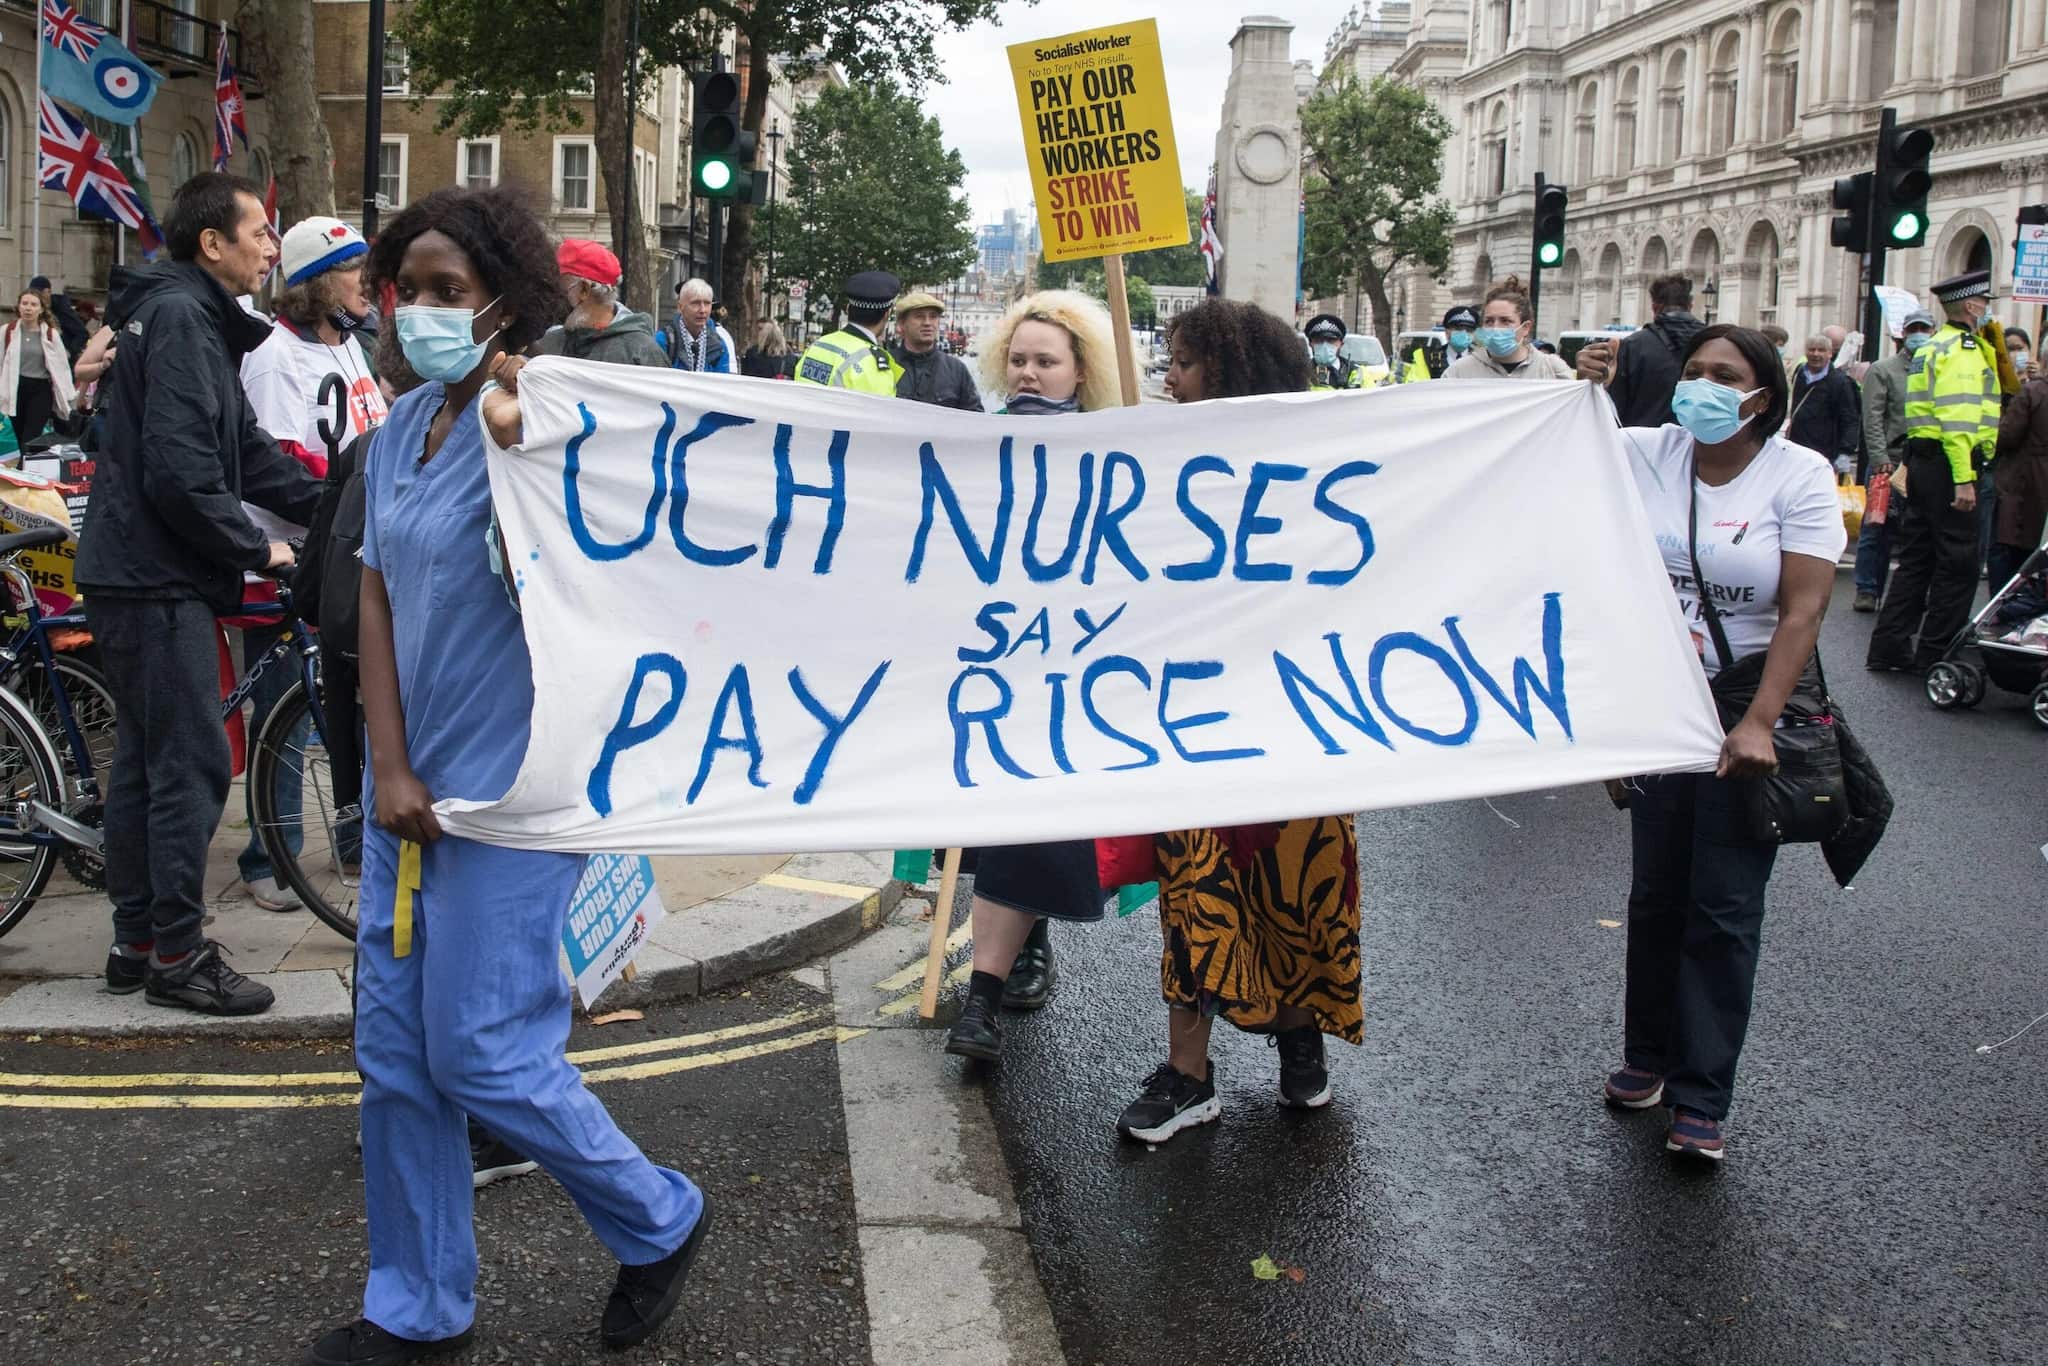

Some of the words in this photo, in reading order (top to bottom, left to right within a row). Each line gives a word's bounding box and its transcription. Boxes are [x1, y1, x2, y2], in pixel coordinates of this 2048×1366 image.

[1030, 73, 1073, 111] PAY
[1082, 63, 1137, 101] OUR
[1054, 62, 1073, 75] Tory
[1074, 58, 1096, 71] NHS
[1036, 100, 1126, 144] HEALTH
[1040, 129, 1161, 177] WORKERS
[1047, 168, 1135, 211] STRIKE
[1051, 209, 1084, 243] TO
[1089, 201, 1142, 239] WIN
[562, 401, 850, 576] UCH
[905, 435, 1382, 588] NURSES
[957, 601, 1127, 664] SAY
[586, 652, 891, 819] PAY
[947, 654, 1266, 790] RISE
[1272, 592, 1574, 756] NOW
[569, 879, 615, 940] FROM
[611, 872, 646, 926] SAVE
[579, 914, 615, 960] OUR
